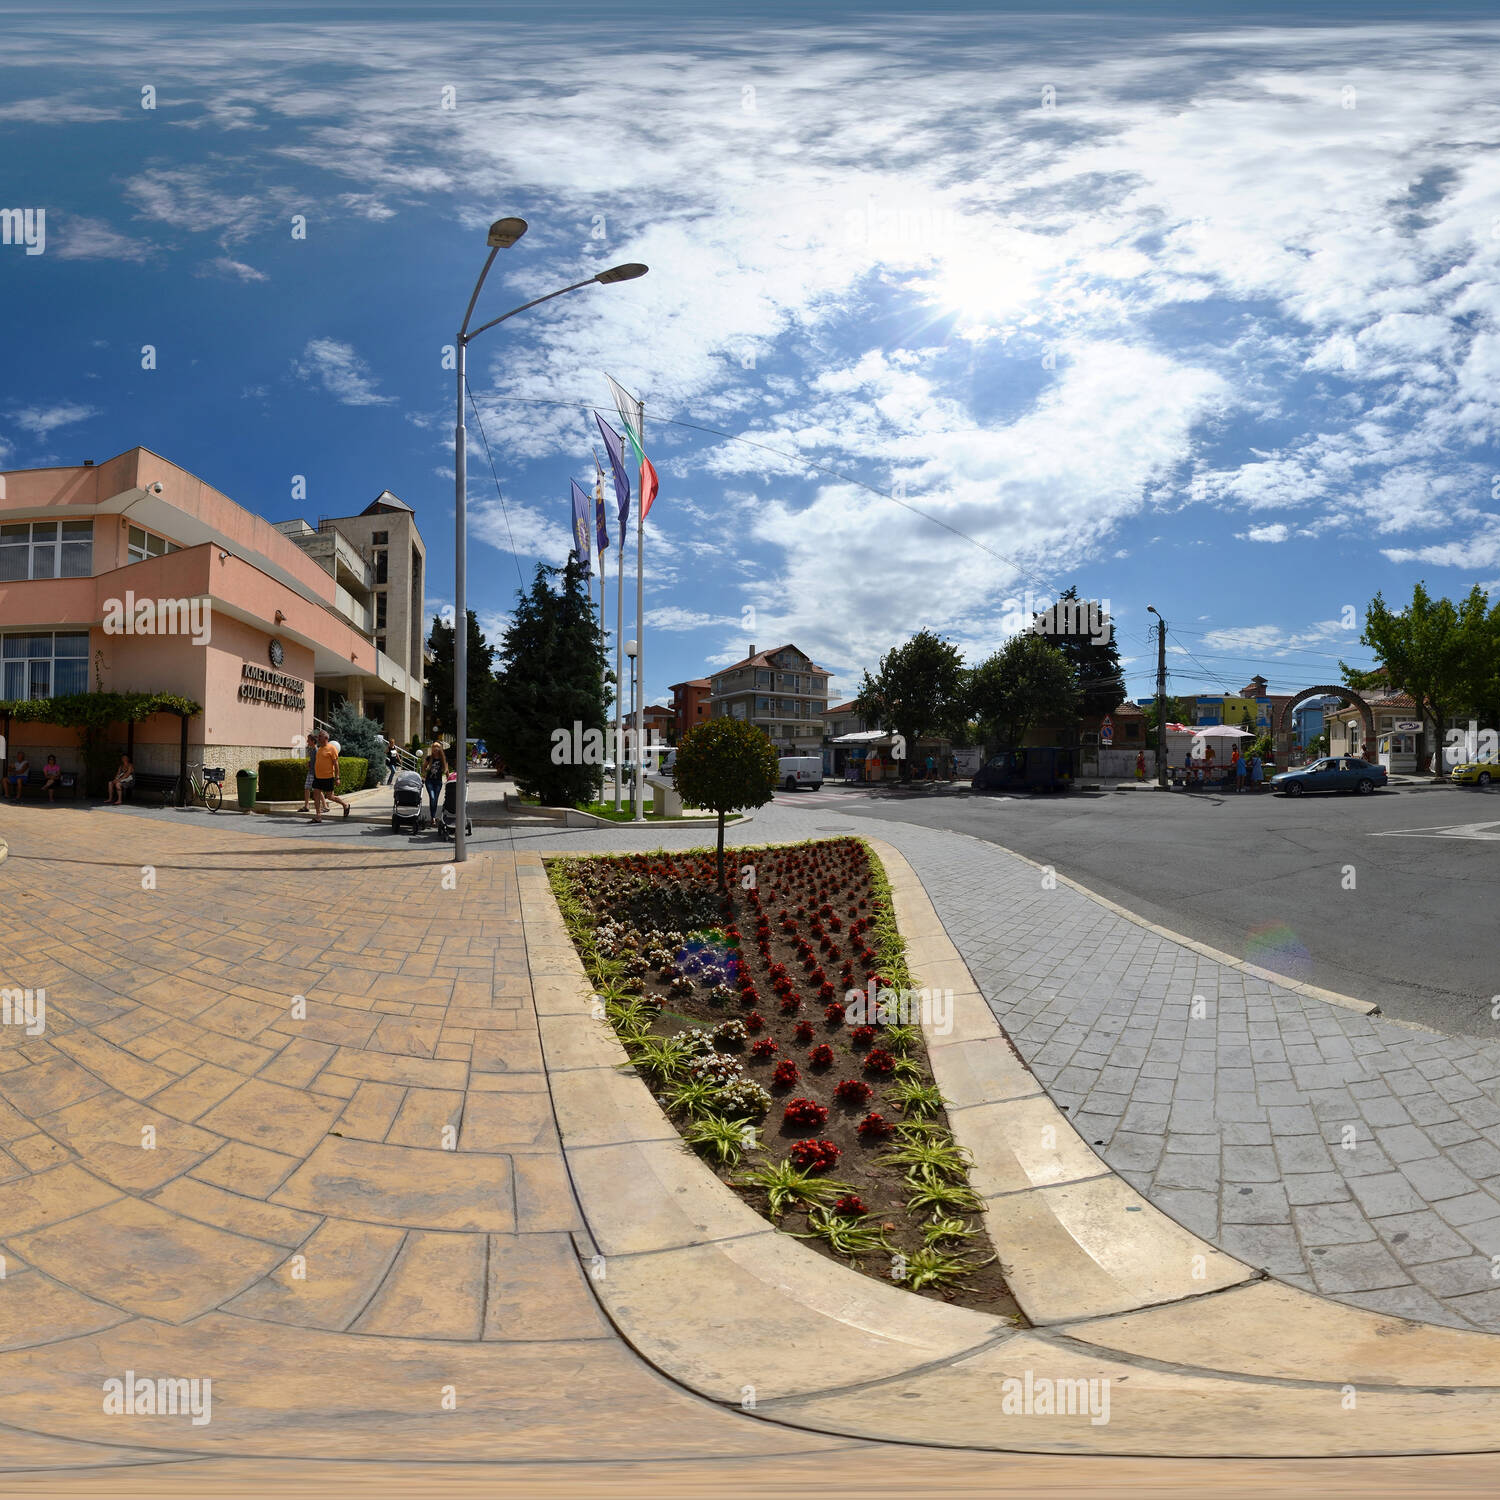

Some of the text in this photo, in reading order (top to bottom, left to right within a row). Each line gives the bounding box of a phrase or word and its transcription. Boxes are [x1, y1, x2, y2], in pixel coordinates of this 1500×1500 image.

[244, 664, 305, 694] КМЕТСТВО РАВДА
[240, 684, 306, 709] GUILD HALL RAVDA
